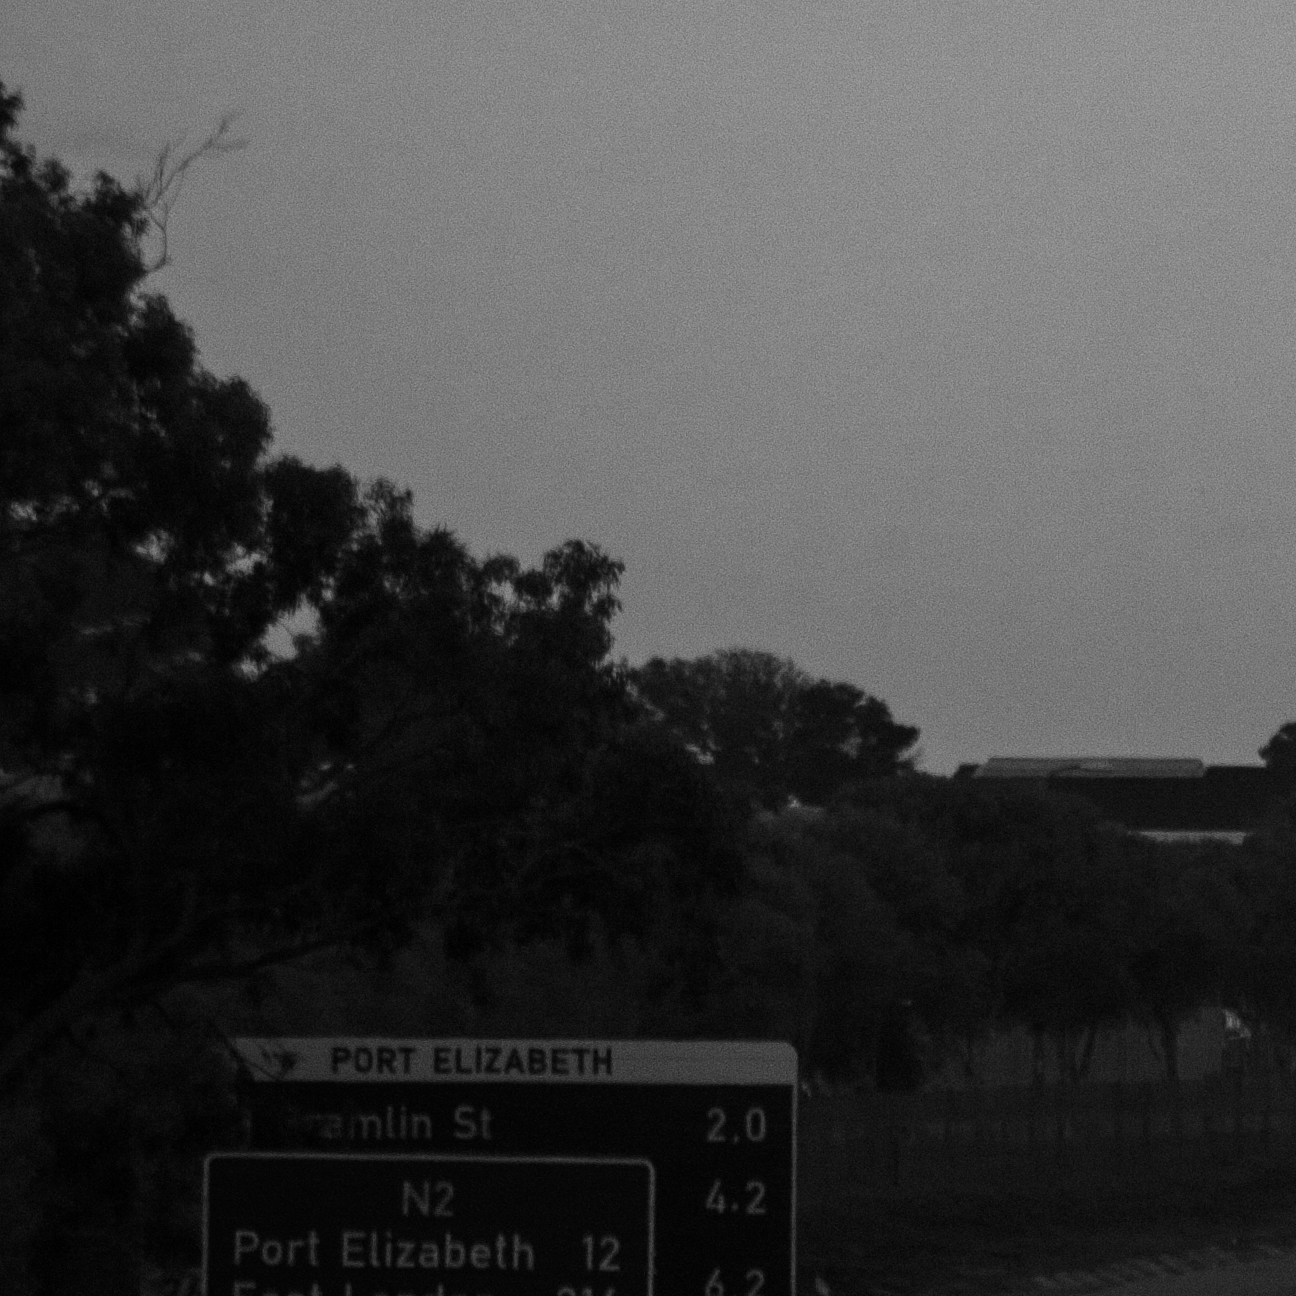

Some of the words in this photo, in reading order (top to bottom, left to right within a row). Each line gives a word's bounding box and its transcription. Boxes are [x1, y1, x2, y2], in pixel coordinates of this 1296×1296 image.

[331, 1046, 415, 1074] PORT
[433, 1046, 612, 1076] ELIZABETH
[453, 1104, 493, 1141] St
[402, 1179, 455, 1217] N2
[233, 1228, 321, 1268] Port
[341, 1229, 535, 1272] Elizabeth
[583, 1232, 621, 1272] 12
